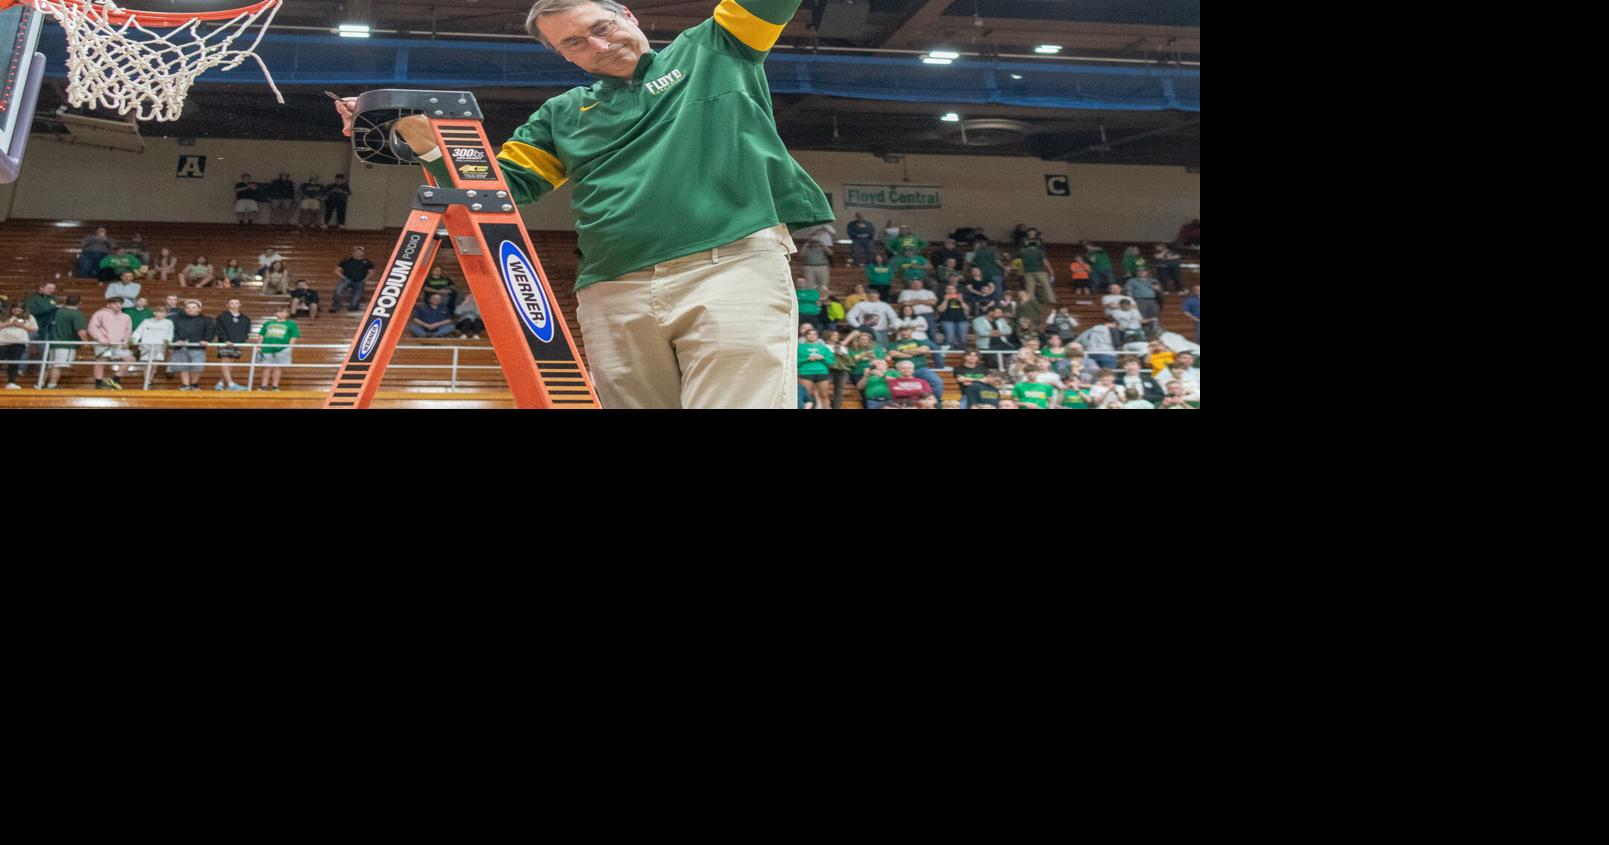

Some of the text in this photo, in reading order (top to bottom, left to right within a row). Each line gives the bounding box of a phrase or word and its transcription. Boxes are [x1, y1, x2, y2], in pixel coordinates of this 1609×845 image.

[645, 69, 682, 95] FLOYD
[178, 157, 203, 177] A
[847, 189, 939, 204] Floyd Central
[1047, 176, 1066, 195] C
[372, 234, 421, 318] PODIUM PODIO
[509, 261, 545, 321] WERNER
[363, 325, 378, 352] WERNER
